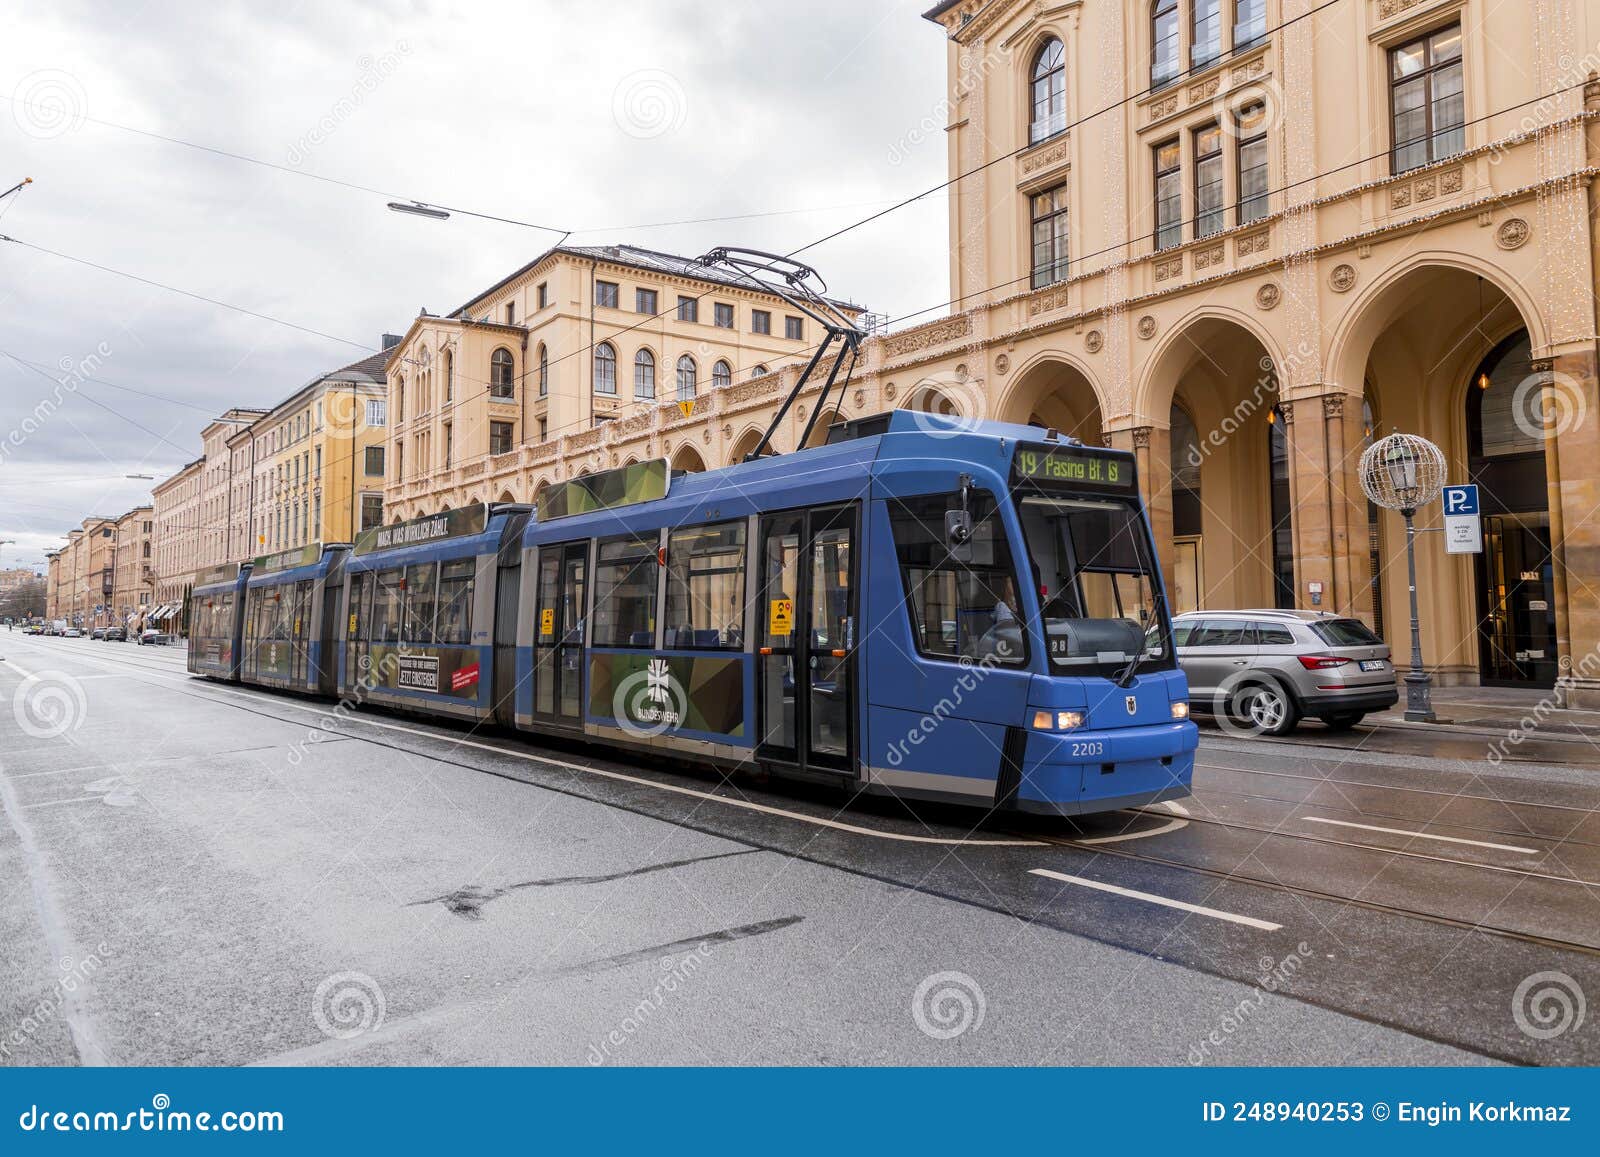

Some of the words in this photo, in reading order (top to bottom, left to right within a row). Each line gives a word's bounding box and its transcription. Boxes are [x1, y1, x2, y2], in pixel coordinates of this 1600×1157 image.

[1019, 451, 1037, 475] 19
[1045, 456, 1084, 479] Pasing
[1447, 489, 1467, 512] P
[392, 527, 404, 545] WAS
[404, 520, 430, 542] WIRKLICH
[399, 670, 412, 684] JETZT
[637, 707, 679, 722] BUNDESWEHR
[1071, 742, 1103, 757] 2203
